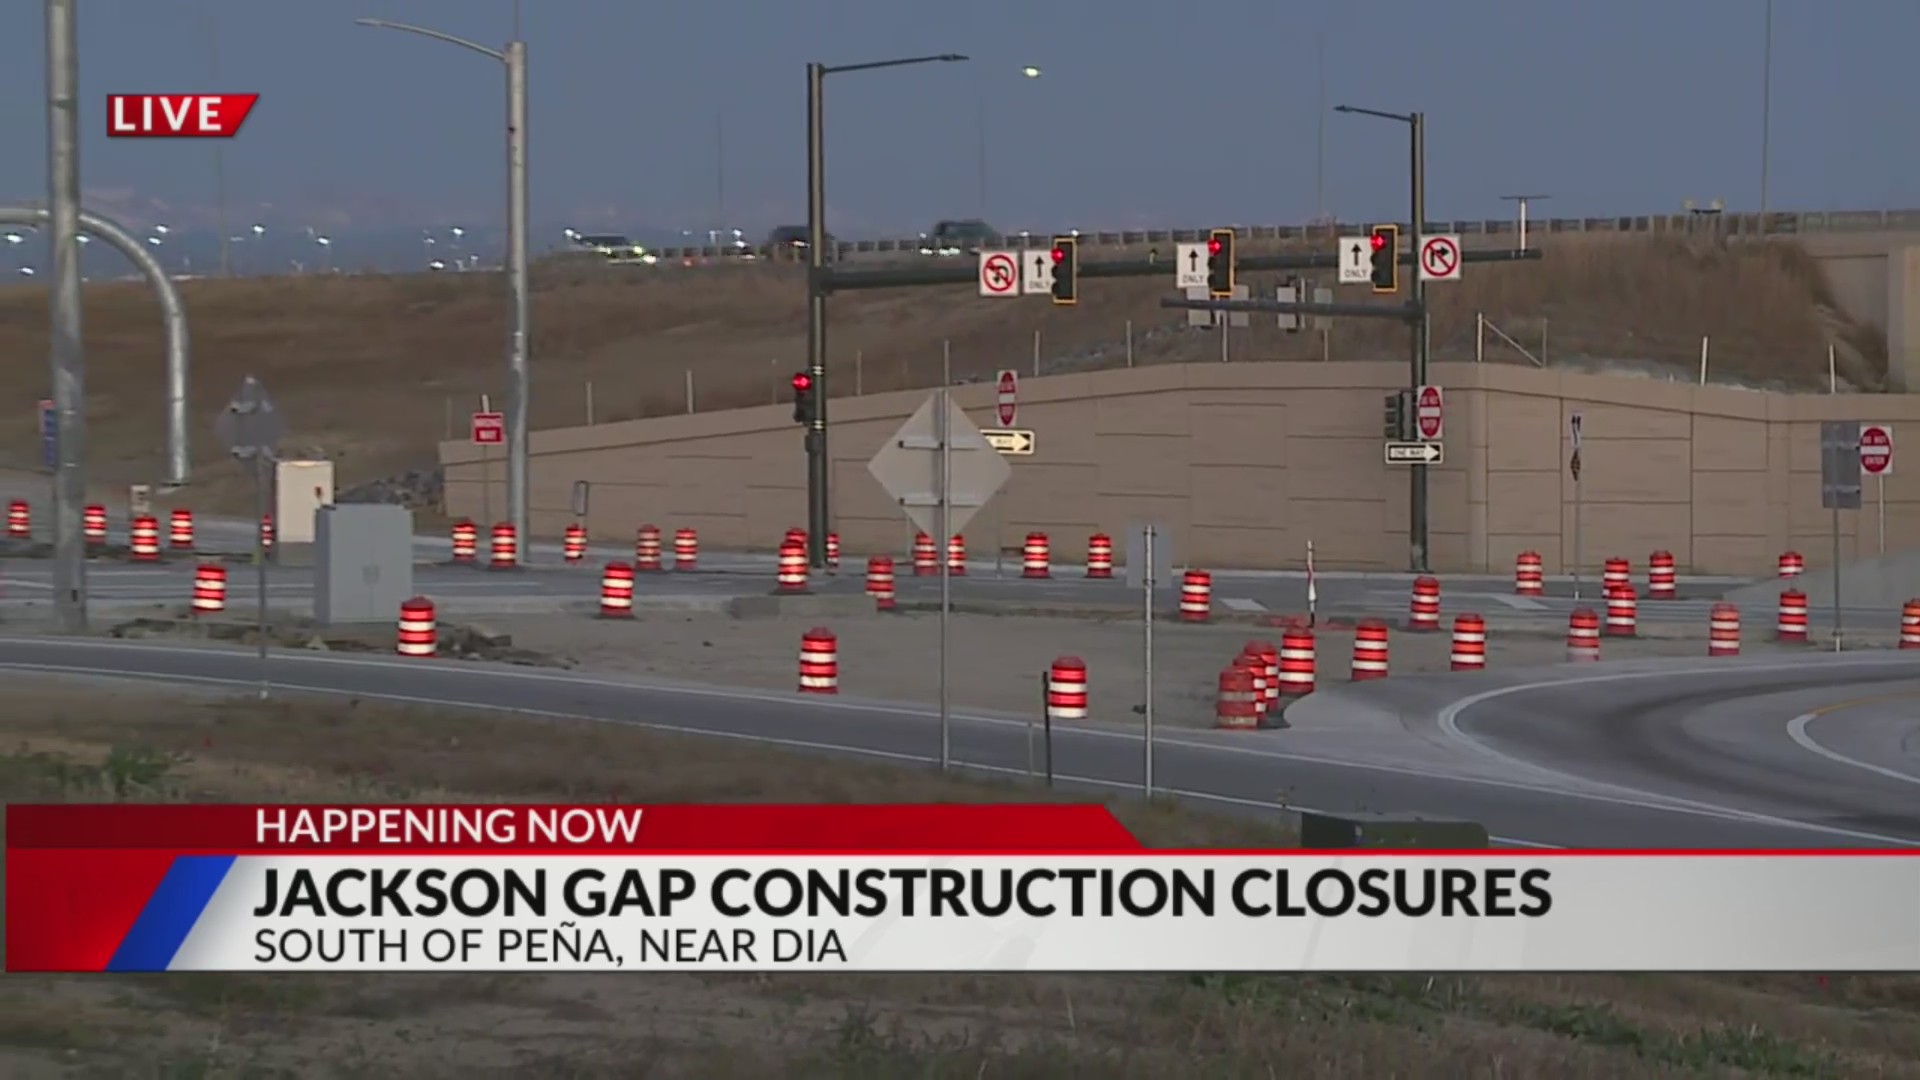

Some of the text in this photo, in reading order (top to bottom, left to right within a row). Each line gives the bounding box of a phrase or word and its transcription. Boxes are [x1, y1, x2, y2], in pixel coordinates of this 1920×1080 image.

[1344, 268, 1367, 278] ONLY
[1181, 274, 1204, 284] ONLY
[1028, 279, 1051, 289] ONLY
[1862, 436, 1887, 444] DO NOT
[1410, 449, 1424, 457] WAY
[1864, 456, 1885, 465] ENTER
